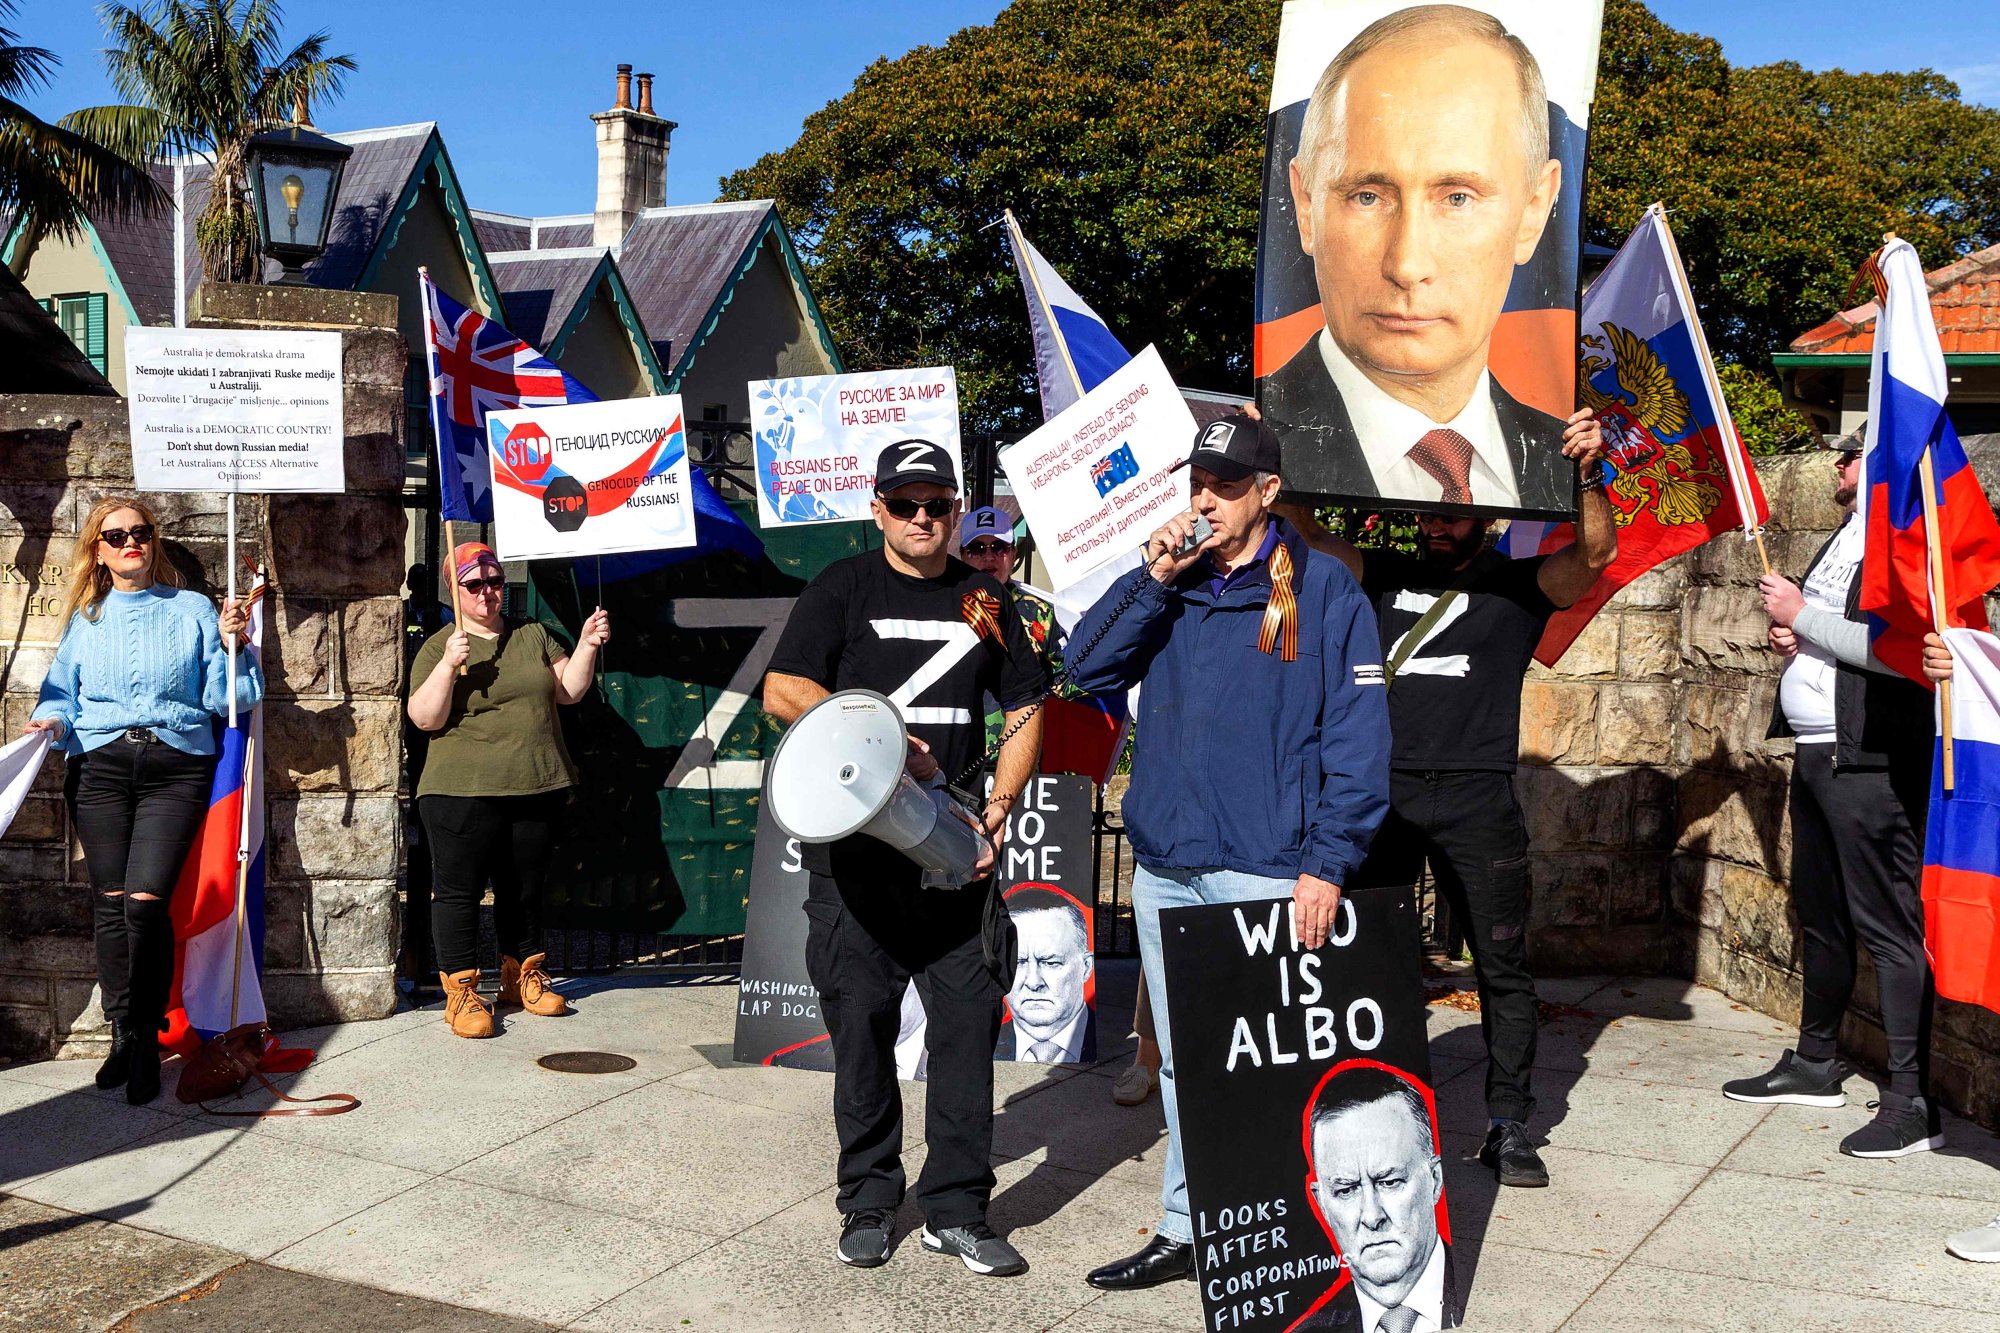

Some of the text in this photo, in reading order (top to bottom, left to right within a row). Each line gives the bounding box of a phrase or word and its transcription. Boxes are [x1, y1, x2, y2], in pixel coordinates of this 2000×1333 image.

[163, 347, 305, 360] Australia je demokratska drama
[136, 366, 174, 378] Nemojte
[177, 367, 208, 377] ukidati
[219, 369, 271, 380] zabranjivati
[275, 369, 301, 378] Ruske
[305, 369, 335, 381] medije
[218, 381, 262, 392] Australiji.
[839, 383, 945, 405] РУССКИЕ ЗА МИР
[137, 393, 181, 403] Dozvolite
[289, 397, 329, 407] opinions
[841, 407, 906, 426] НА ЗЕМЛЕ!
[1073, 416, 1105, 444] INSTEAD
[1104, 407, 1116, 422] OF
[1114, 383, 1149, 417] SENDING
[144, 424, 184, 434] Australia
[186, 425, 194, 434] is
[203, 425, 274, 435] DEMOCRATIC
[276, 425, 332, 435] COUNTRY!
[555, 427, 666, 452] ГЕНОЦИД РУССКИХ!
[1071, 443, 1094, 466] SEND
[1092, 412, 1138, 454] DIPLOMACY!
[193, 442, 213, 451] shut
[214, 442, 239, 452] down
[241, 442, 276, 452] Russian
[278, 442, 309, 452] media!
[507, 436, 550, 467] STOP
[895, 442, 937, 472] Z
[161, 458, 319, 468] Let Australians ACCESS Alternative
[770, 456, 858, 477] RUSSIANS FOR
[217, 471, 261, 482] Opinions!
[587, 473, 678, 492] GENOCIDE OF THE
[771, 480, 811, 497] PEACE
[814, 478, 833, 493] ON
[548, 495, 584, 514] STOP
[626, 492, 680, 509] RUSSIANS!
[978, 512, 993, 525] Z
[1056, 503, 1114, 546] Австралия!!
[1112, 480, 1149, 512] Вместо
[1064, 483, 1179, 564] используй дипломатию!
[1386, 588, 1471, 678] Z
[869, 618, 981, 725] Z
[1279, 953, 1323, 1007] IS
[740, 999, 772, 1016] LAP
[781, 1002, 817, 1019] DOG
[1226, 997, 1384, 1072] ALBO
[1200, 1198, 1288, 1238] LOOKS
[1205, 1226, 1289, 1271] AFTER
[1207, 1252, 1352, 1302] CORPORATIONS
[1214, 1291, 1290, 1332] FIRST
